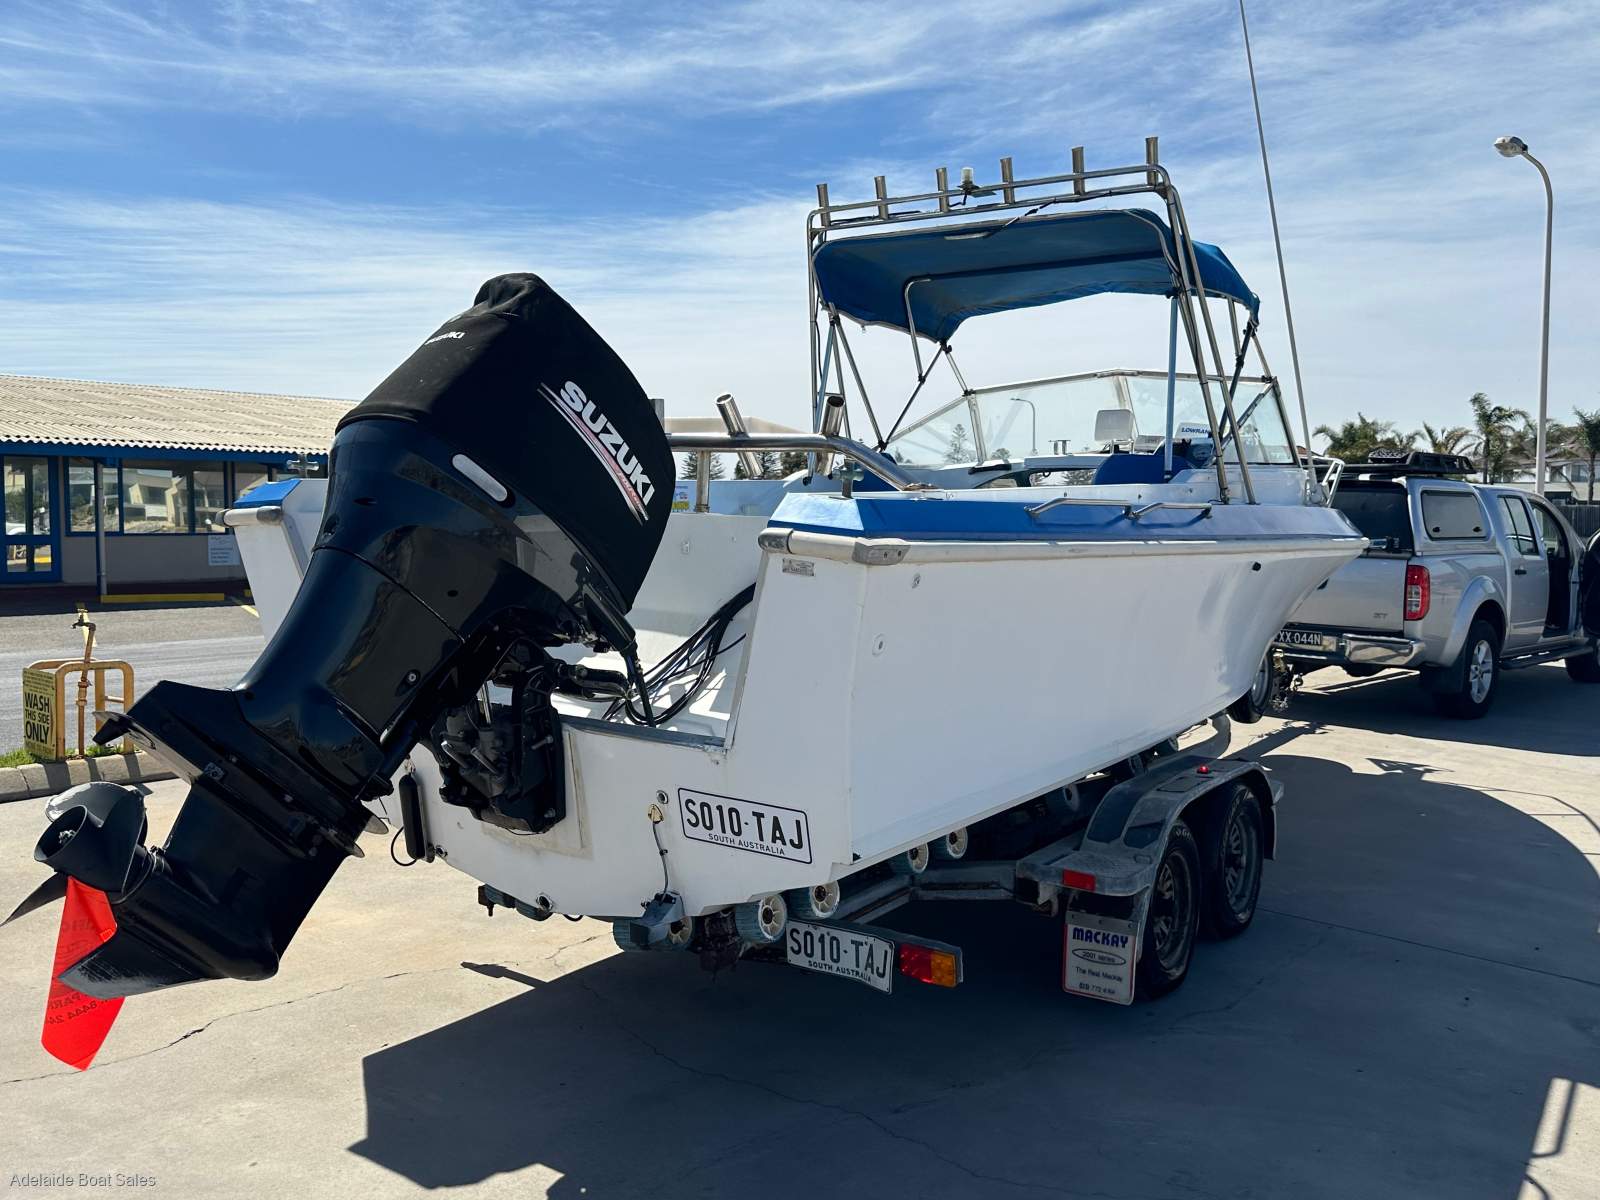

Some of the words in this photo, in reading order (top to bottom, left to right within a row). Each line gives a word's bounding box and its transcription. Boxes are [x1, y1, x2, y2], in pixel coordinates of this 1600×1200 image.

[560, 380, 655, 506] SUZUKI
[25, 692, 50, 713] WASH
[25, 708, 36, 721] THIS
[38, 711, 50, 725] SIDE
[25, 720, 50, 744] ONLY
[708, 833, 735, 845] SOUTH
[738, 841, 785, 855] AUSTRALIA
[1072, 927, 1129, 948] MACKAY
[808, 960, 833, 971] SOUTH
[836, 967, 871, 983] AUSTRALIA
